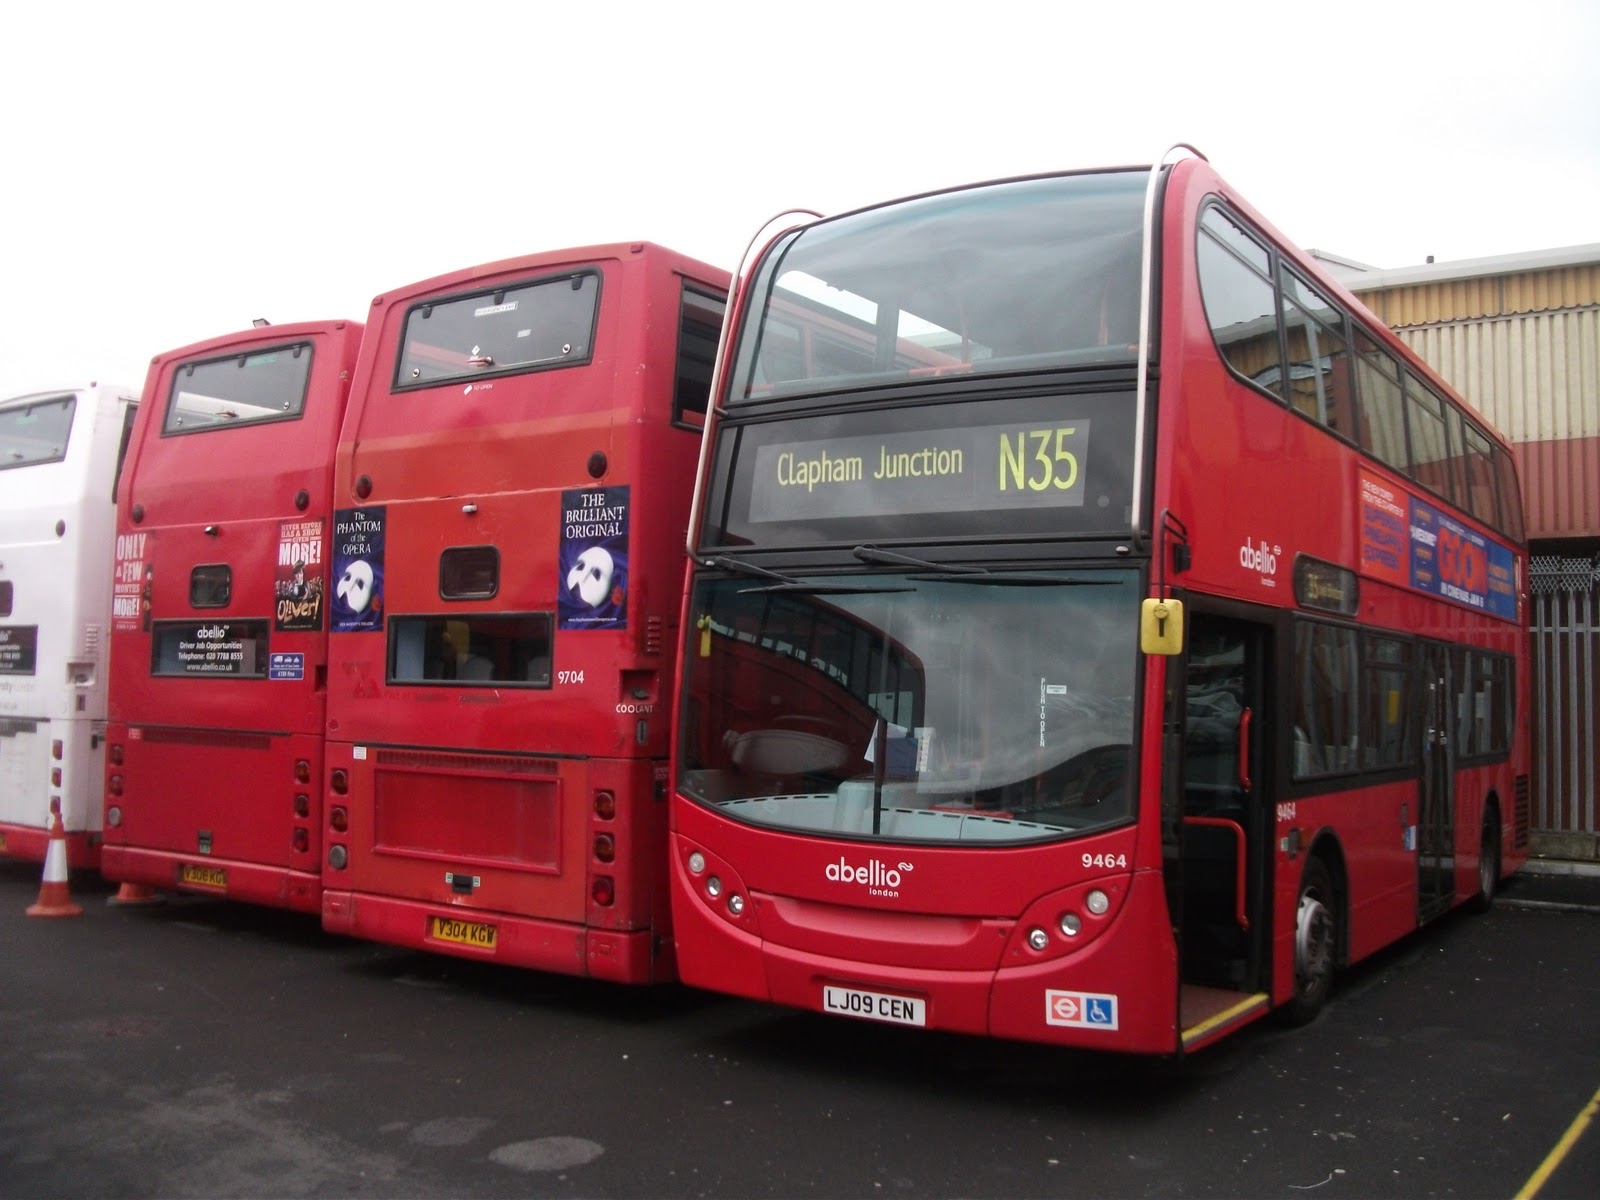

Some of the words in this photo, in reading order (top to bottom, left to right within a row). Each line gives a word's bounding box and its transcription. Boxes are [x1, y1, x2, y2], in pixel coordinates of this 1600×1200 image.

[999, 427, 1078, 491] N35
[777, 450, 862, 492] Clapham
[873, 445, 963, 479] Junction
[581, 493, 605, 508] THE
[354, 511, 366, 521] The
[565, 506, 625, 524] BRILLIANT
[281, 530, 295, 538] HAS
[302, 528, 322, 537] SHOW
[337, 520, 381, 535] PHANTOM
[566, 522, 623, 539] ORIGINAL
[116, 533, 147, 560] ONLY
[278, 540, 322, 566] MORE!
[342, 543, 371, 556] OPERA
[1240, 536, 1277, 575] abellio
[115, 566, 122, 577] A
[122, 561, 143, 583] FEW
[114, 583, 140, 594] MONTHS
[113, 598, 140, 616] MORE!
[197, 625, 225, 639] abellio
[179, 641, 195, 649] Driver
[196, 641, 205, 649] Job
[206, 641, 242, 651] Opportunities
[178, 651, 205, 661] Telephone:
[557, 670, 585, 684] 9704
[615, 703, 654, 714] COOLANT
[1276, 802, 1296, 822] 9464
[1081, 853, 1127, 869] 9464
[825, 856, 901, 888] abellio
[869, 887, 899, 898] london
[439, 920, 468, 939] V304
[470, 925, 495, 944] KGW
[827, 989, 873, 1013] LJ09
[878, 1000, 914, 1021] CEN
